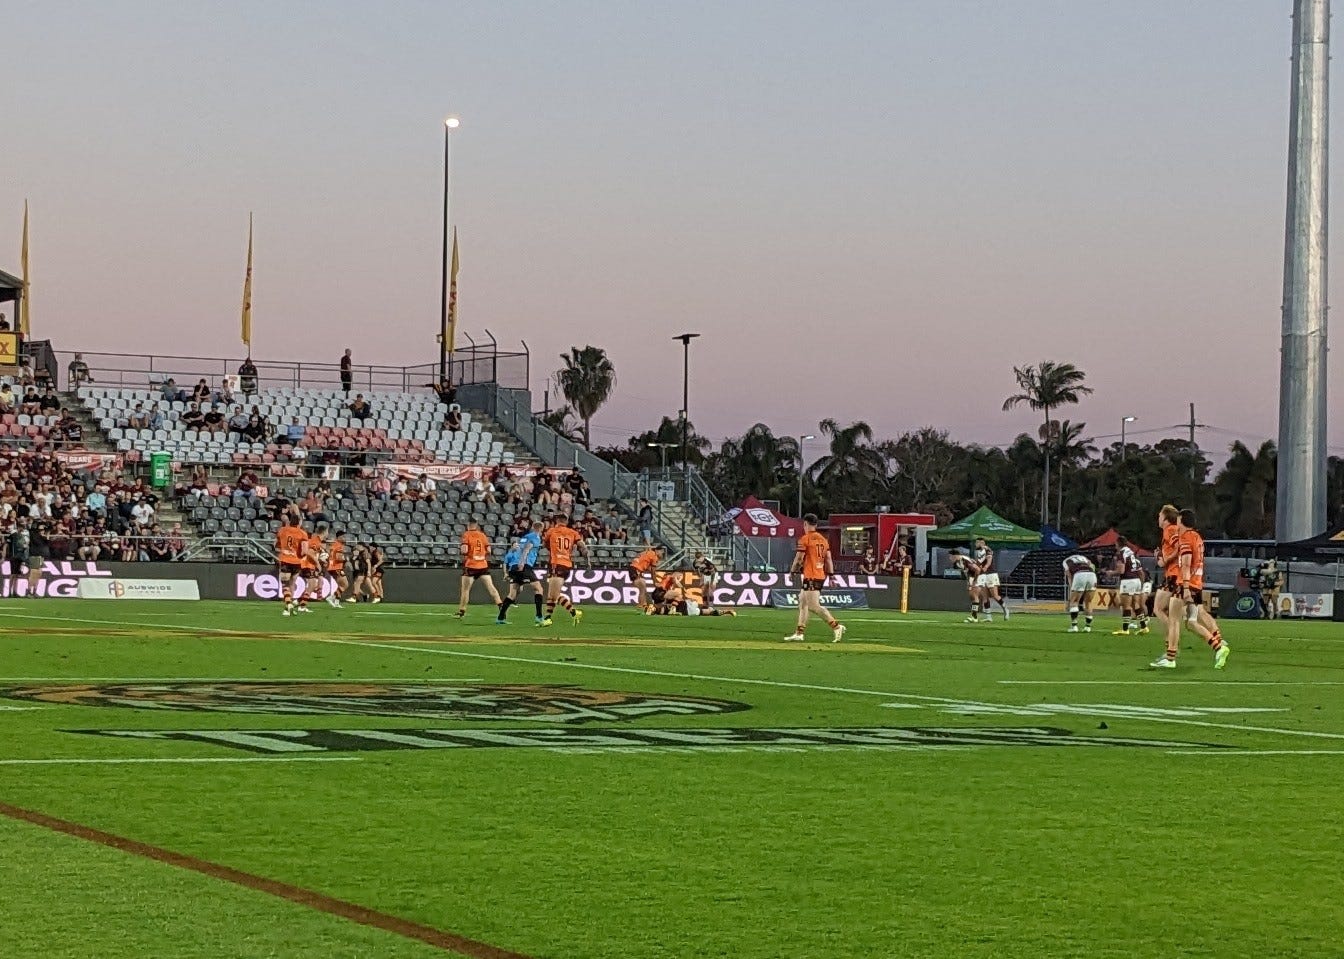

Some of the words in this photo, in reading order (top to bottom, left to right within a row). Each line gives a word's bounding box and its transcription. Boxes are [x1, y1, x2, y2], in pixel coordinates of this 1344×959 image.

[557, 537, 570, 551] 10
[818, 593, 853, 604] STPLUS
[99, 727, 1213, 753] TIGERS
